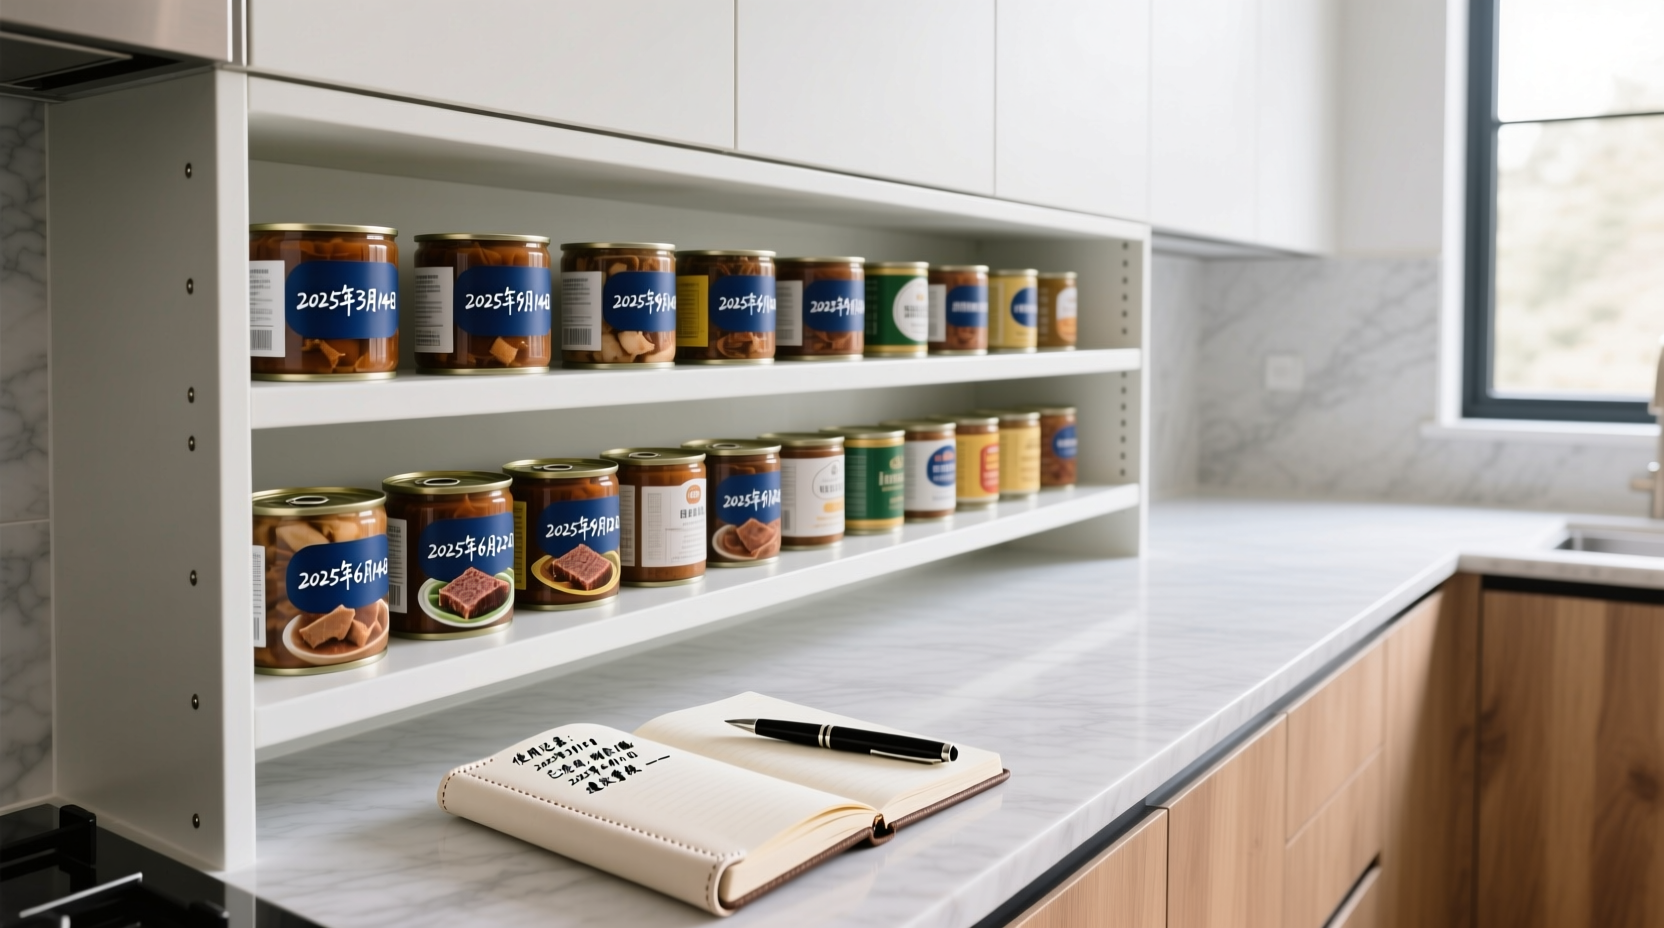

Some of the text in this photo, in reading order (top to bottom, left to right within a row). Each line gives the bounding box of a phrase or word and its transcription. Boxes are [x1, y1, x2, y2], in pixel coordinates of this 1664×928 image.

[296, 284, 396, 317] 2025年3月14日
[298, 557, 388, 591] 2025年6月14日
